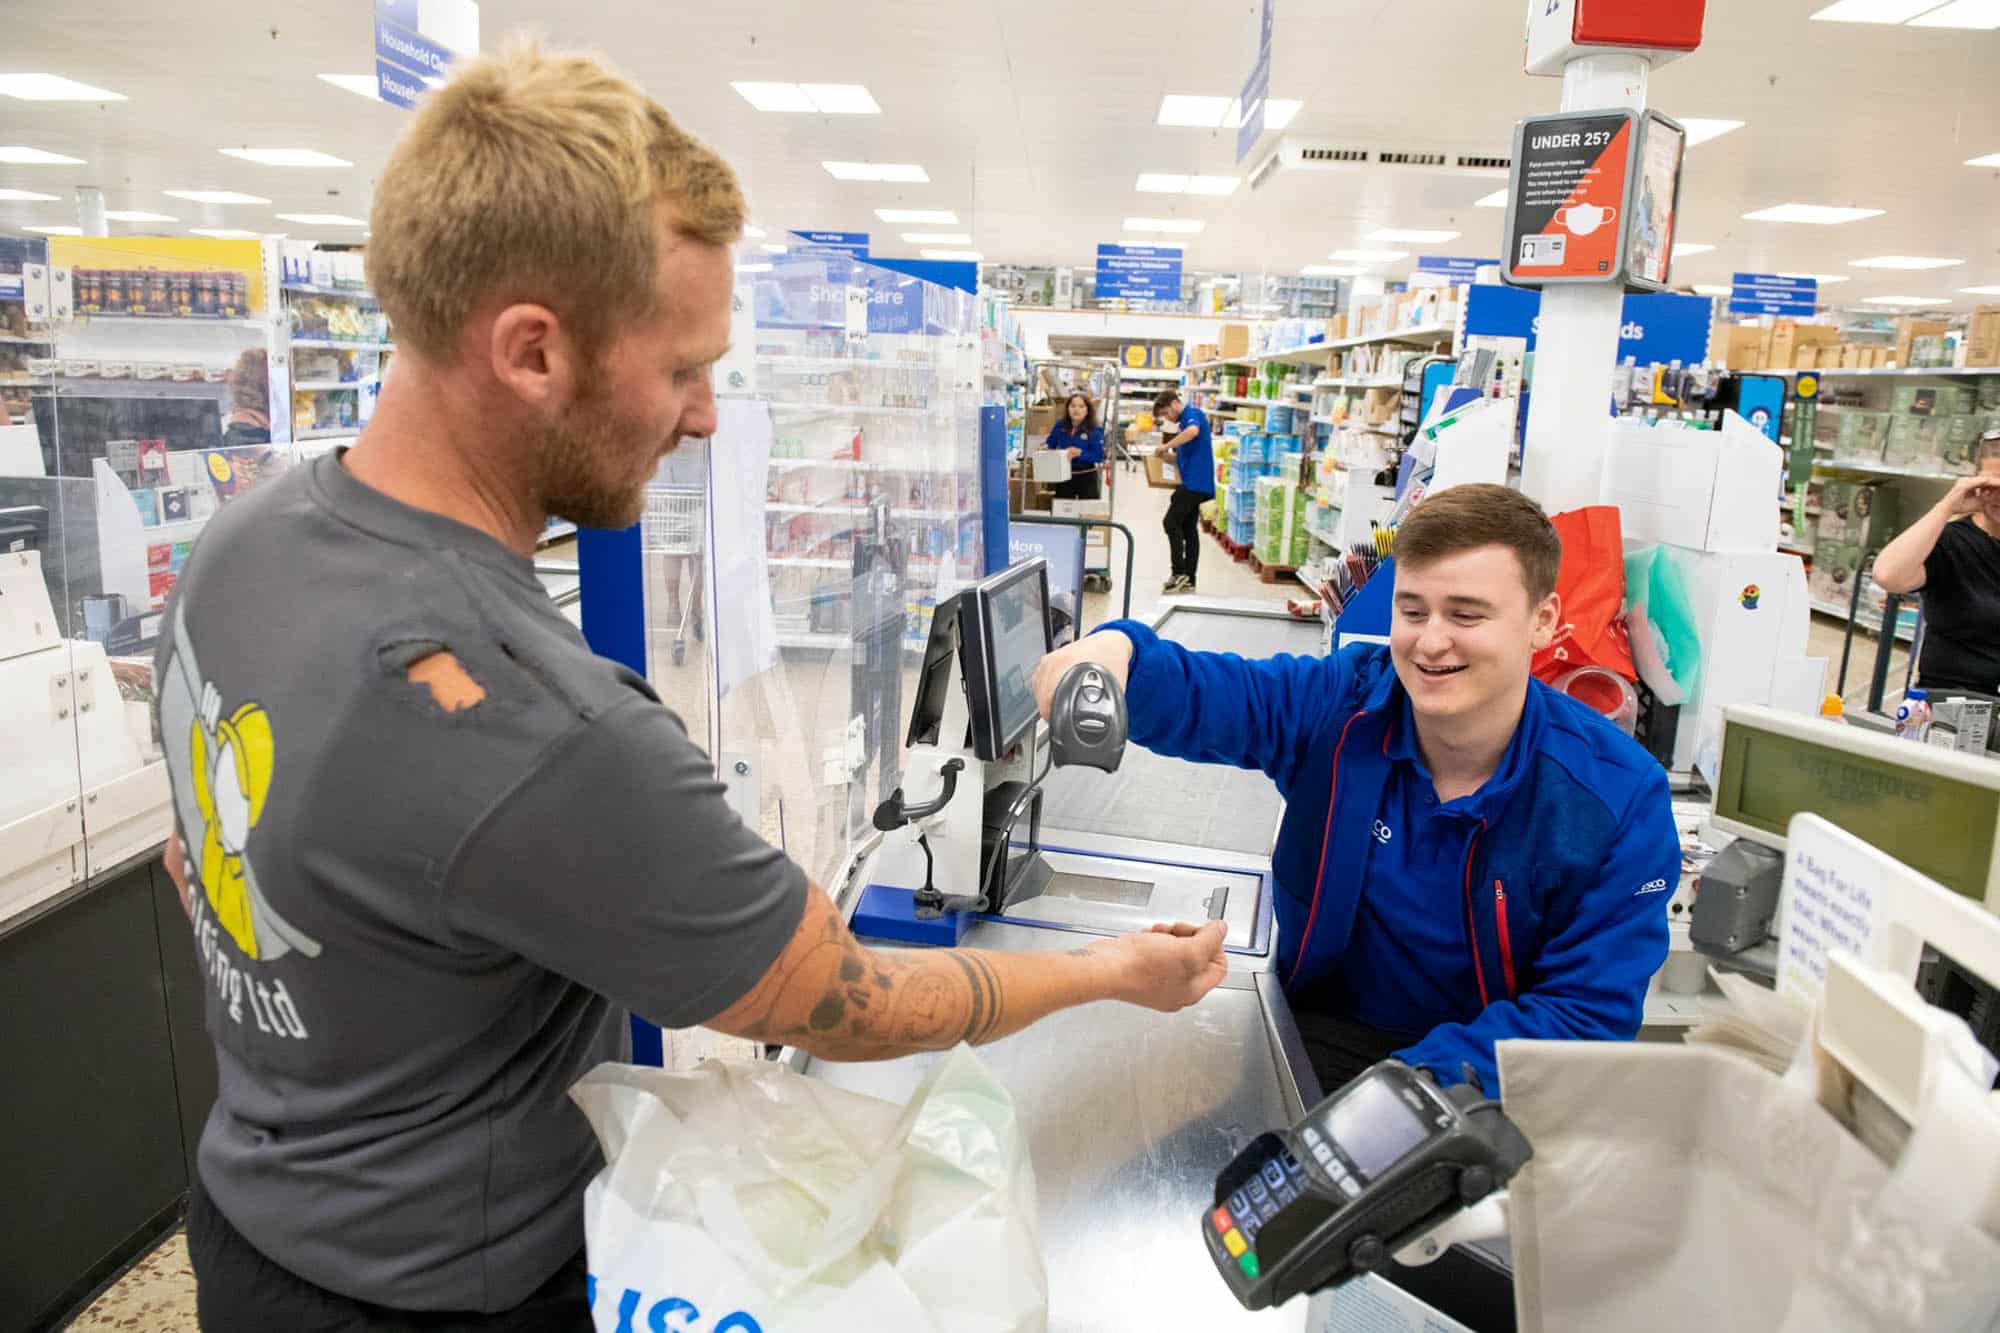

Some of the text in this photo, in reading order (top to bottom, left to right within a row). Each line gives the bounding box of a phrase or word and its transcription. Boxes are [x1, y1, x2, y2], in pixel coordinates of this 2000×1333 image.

[1531, 131, 1611, 150] UNDER 25?
[243, 971, 308, 1038] Ltd
